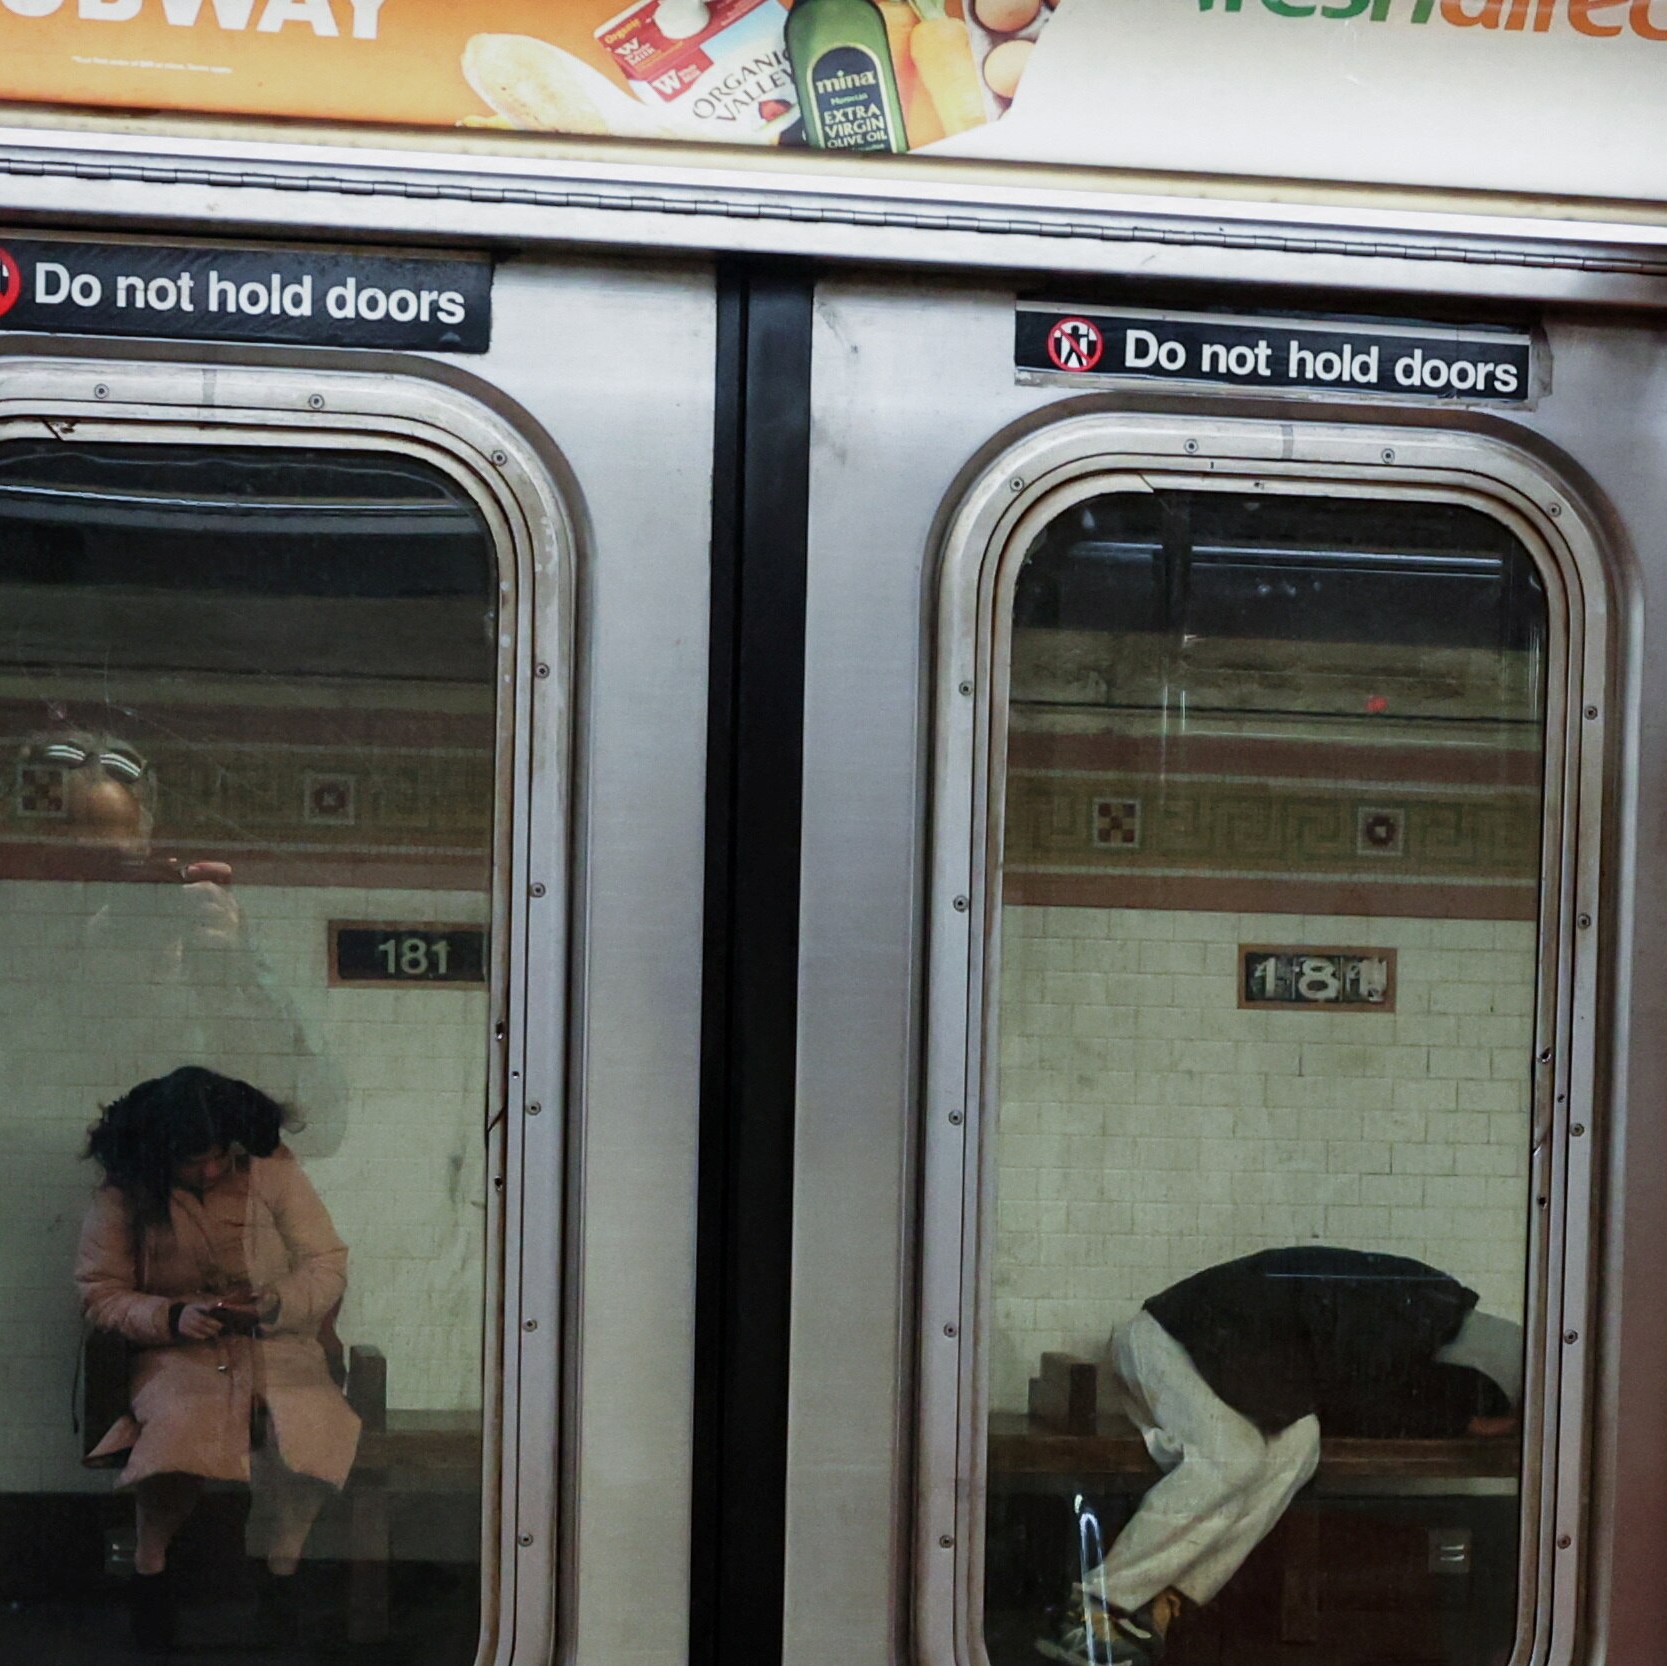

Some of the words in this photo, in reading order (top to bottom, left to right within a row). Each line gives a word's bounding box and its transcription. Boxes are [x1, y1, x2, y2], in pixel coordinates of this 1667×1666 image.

[816, 70, 877, 94] mina
[824, 103, 881, 125] EXTRA
[825, 116, 885, 138] VIRGIN
[827, 134, 865, 149] OLIVE
[866, 131, 888, 143] OIL
[36, 263, 102, 307] Do
[117, 272, 195, 312] not
[209, 271, 313, 317] hold
[326, 277, 466, 324] doors
[1125, 329, 1186, 370] Do
[1202, 340, 1272, 377] not
[1288, 340, 1379, 384] hold
[1395, 348, 1519, 392] doors
[378, 938, 451, 976] 181
